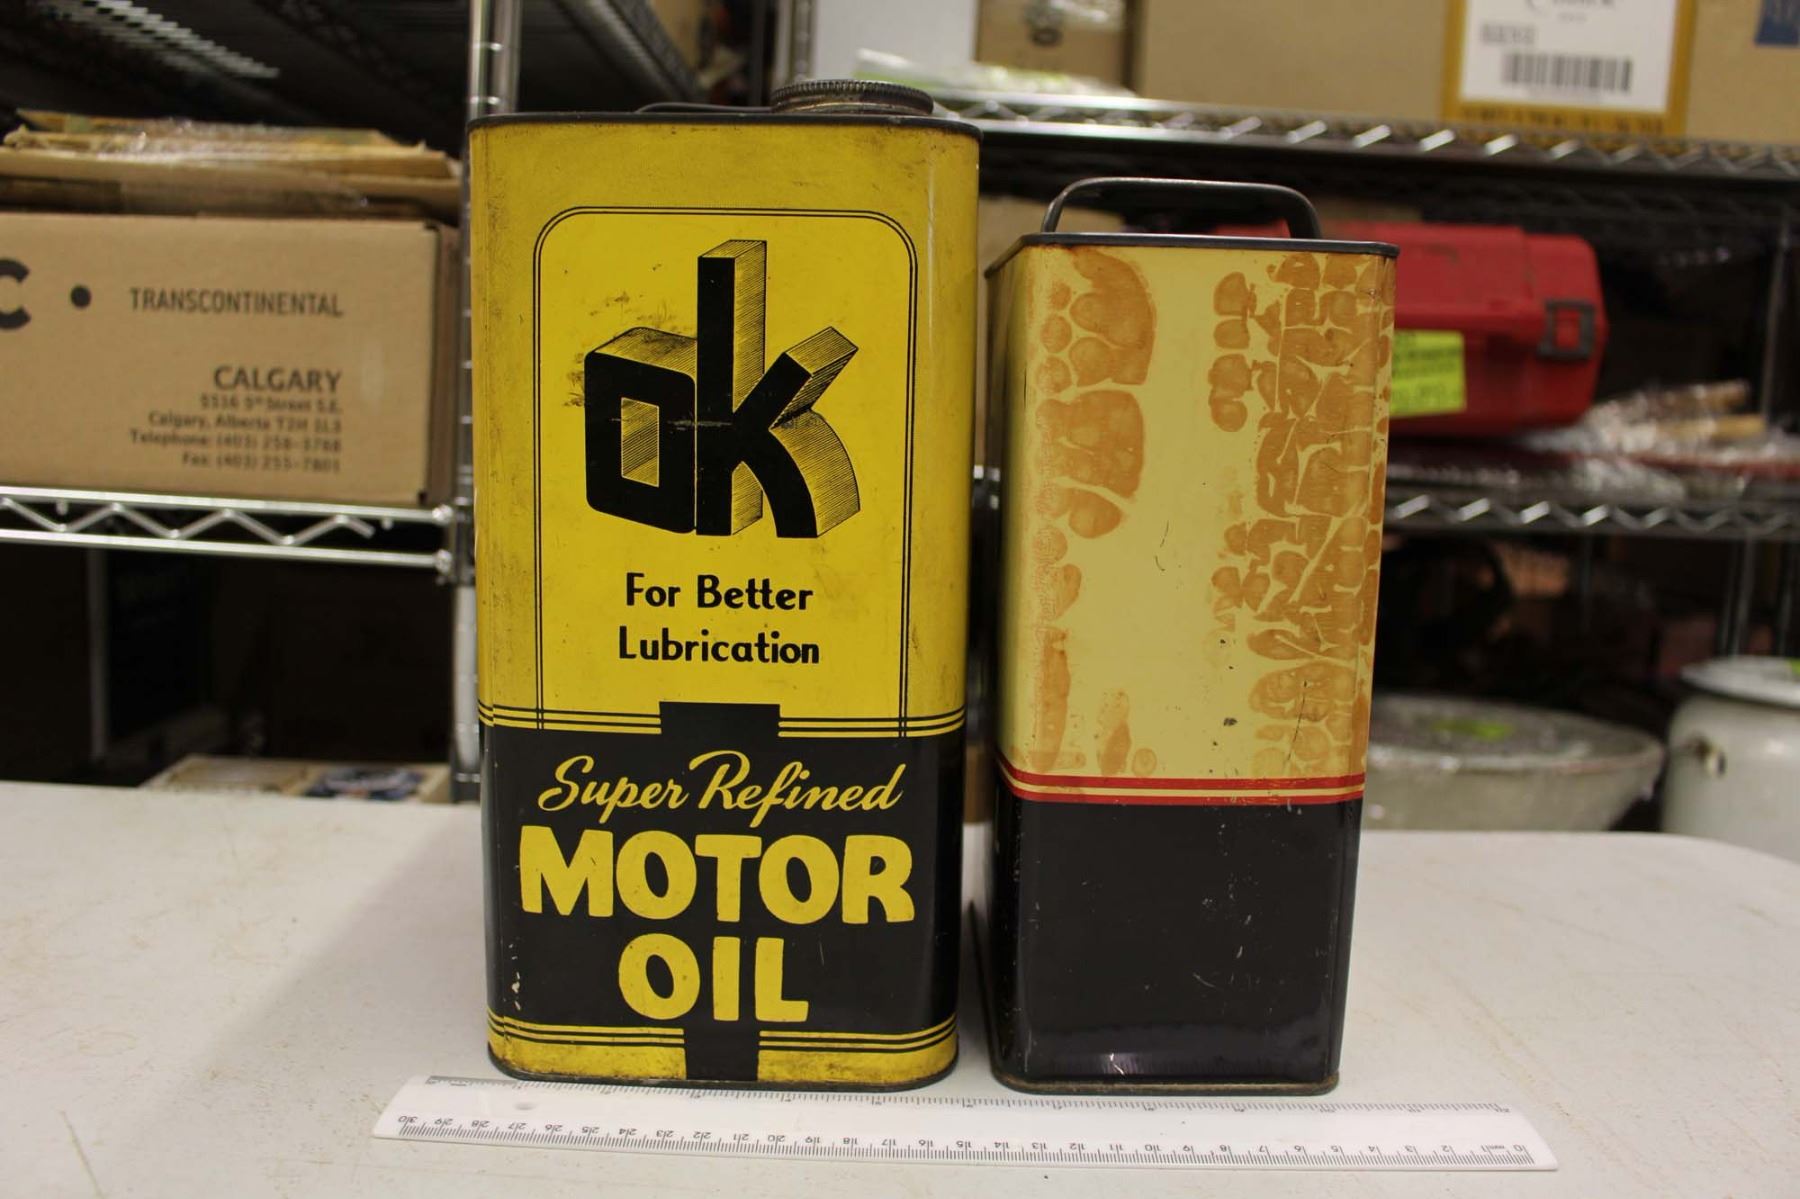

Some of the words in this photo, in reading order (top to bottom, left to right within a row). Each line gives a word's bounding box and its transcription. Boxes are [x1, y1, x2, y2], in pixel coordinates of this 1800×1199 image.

[129, 286, 344, 318] TRANSCONTINENTAL
[213, 364, 342, 392] CALGARY
[215, 413, 271, 430] Alberta
[626, 572, 681, 608] For
[697, 575, 814, 611] Better
[618, 626, 820, 664] Lubrication
[538, 755, 690, 824] Super
[689, 750, 906, 828] Refined
[519, 825, 915, 925] MOTOR
[618, 933, 809, 1022] OIL
[398, 1115, 418, 1124] 30
[434, 1118, 453, 1126] 29
[472, 1120, 490, 1128] 28
[508, 1122, 527, 1130] 27
[545, 1124, 564, 1132] 26
[582, 1126, 599, 1134] 25
[618, 1128, 638, 1136] 24
[656, 1130, 674, 1138] 23
[733, 1133, 750, 1141] 21
[805, 1136, 820, 1144] 19
[843, 1137, 857, 1145] 18
[882, 1138, 896, 1146] 17
[919, 1139, 933, 1147] 16
[956, 1140, 971, 1148] 15
[994, 1141, 1009, 1149] 14
[1032, 1142, 1047, 1150] 13
[1145, 1144, 1160, 1152] 10
